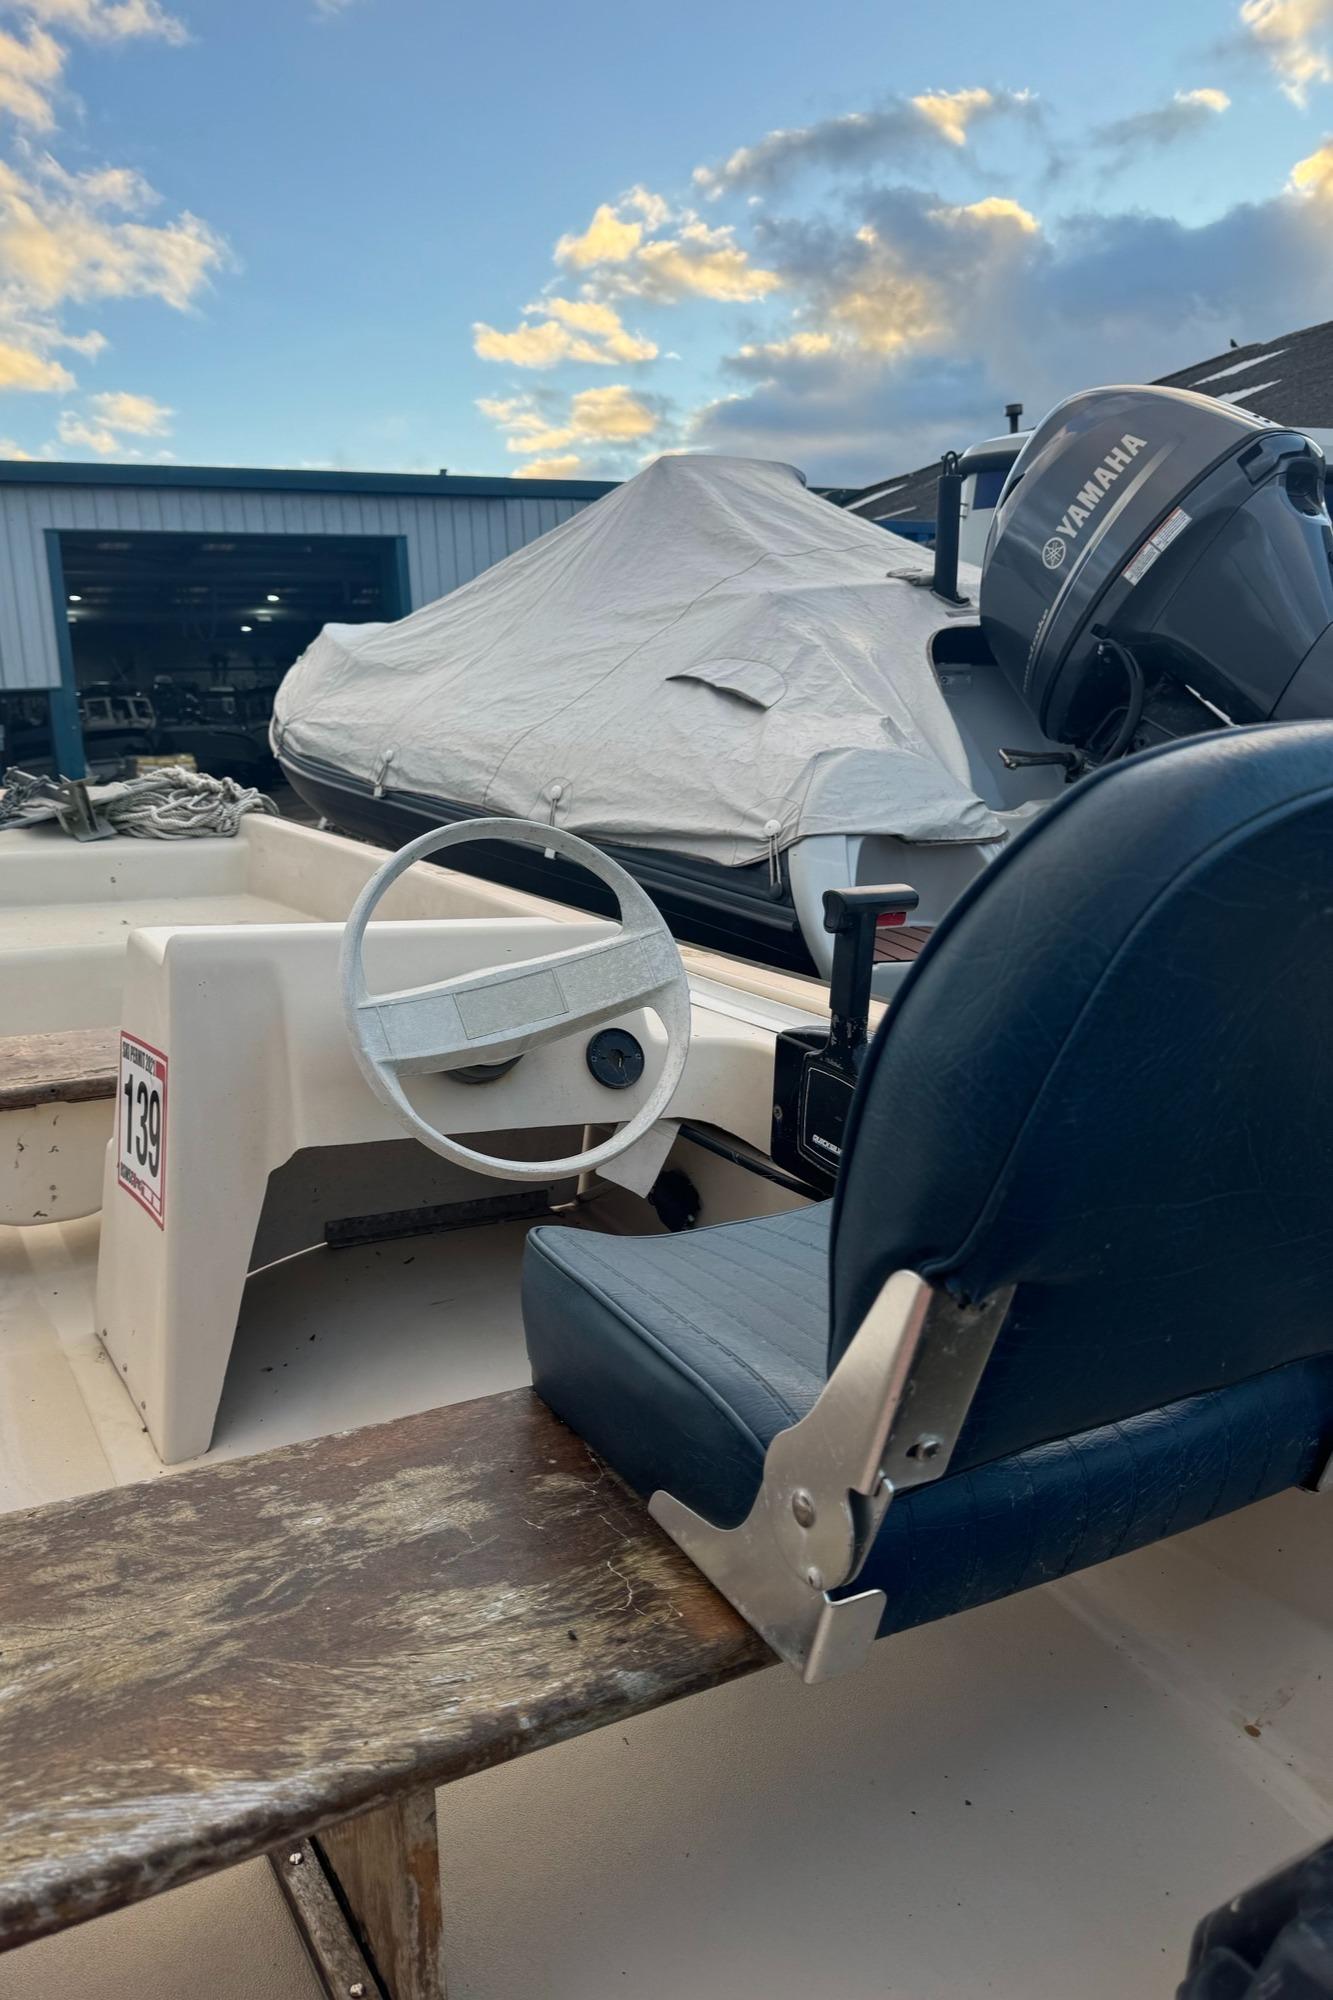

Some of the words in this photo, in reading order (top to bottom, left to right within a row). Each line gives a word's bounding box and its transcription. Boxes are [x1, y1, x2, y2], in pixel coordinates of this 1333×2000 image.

[1055, 433, 1148, 539] YAMAHA
[130, 1045, 146, 1069] PERMIT
[124, 1073, 160, 1178] 139
